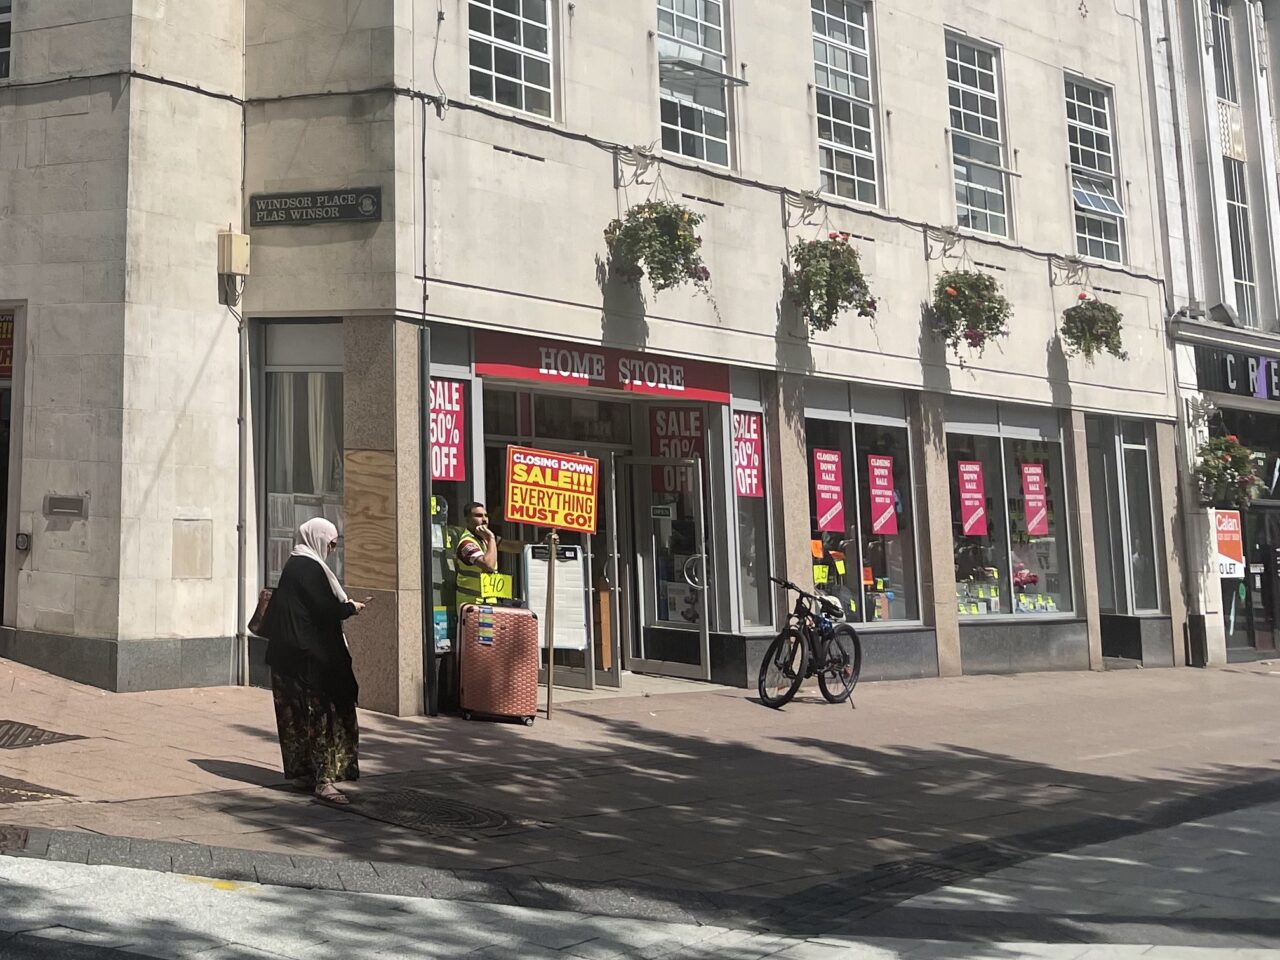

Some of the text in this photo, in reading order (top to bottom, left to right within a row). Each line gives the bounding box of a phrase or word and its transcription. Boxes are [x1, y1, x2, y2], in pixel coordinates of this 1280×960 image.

[255, 194, 356, 210] WINDSOR PLACE
[256, 207, 340, 221] PLAS WINSOR
[539, 347, 685, 391] HOME STORE
[430, 380, 460, 411] SALE
[430, 412, 460, 445] 50%
[655, 410, 701, 437] SALE
[733, 413, 758, 439] SALE
[432, 445, 458, 478] OFF
[513, 453, 593, 474] CLOSING DOWN
[734, 441, 759, 467] 50%
[816, 452, 839, 462] CLOSING
[820, 462, 836, 471] DOWN
[513, 464, 593, 492] SALE!!!
[736, 467, 758, 494] OFF
[511, 486, 593, 515] EVERYTHING
[510, 504, 592, 528] MUST GO!
[1225, 563, 1236, 574] LET
[483, 576, 504, 594] £40
